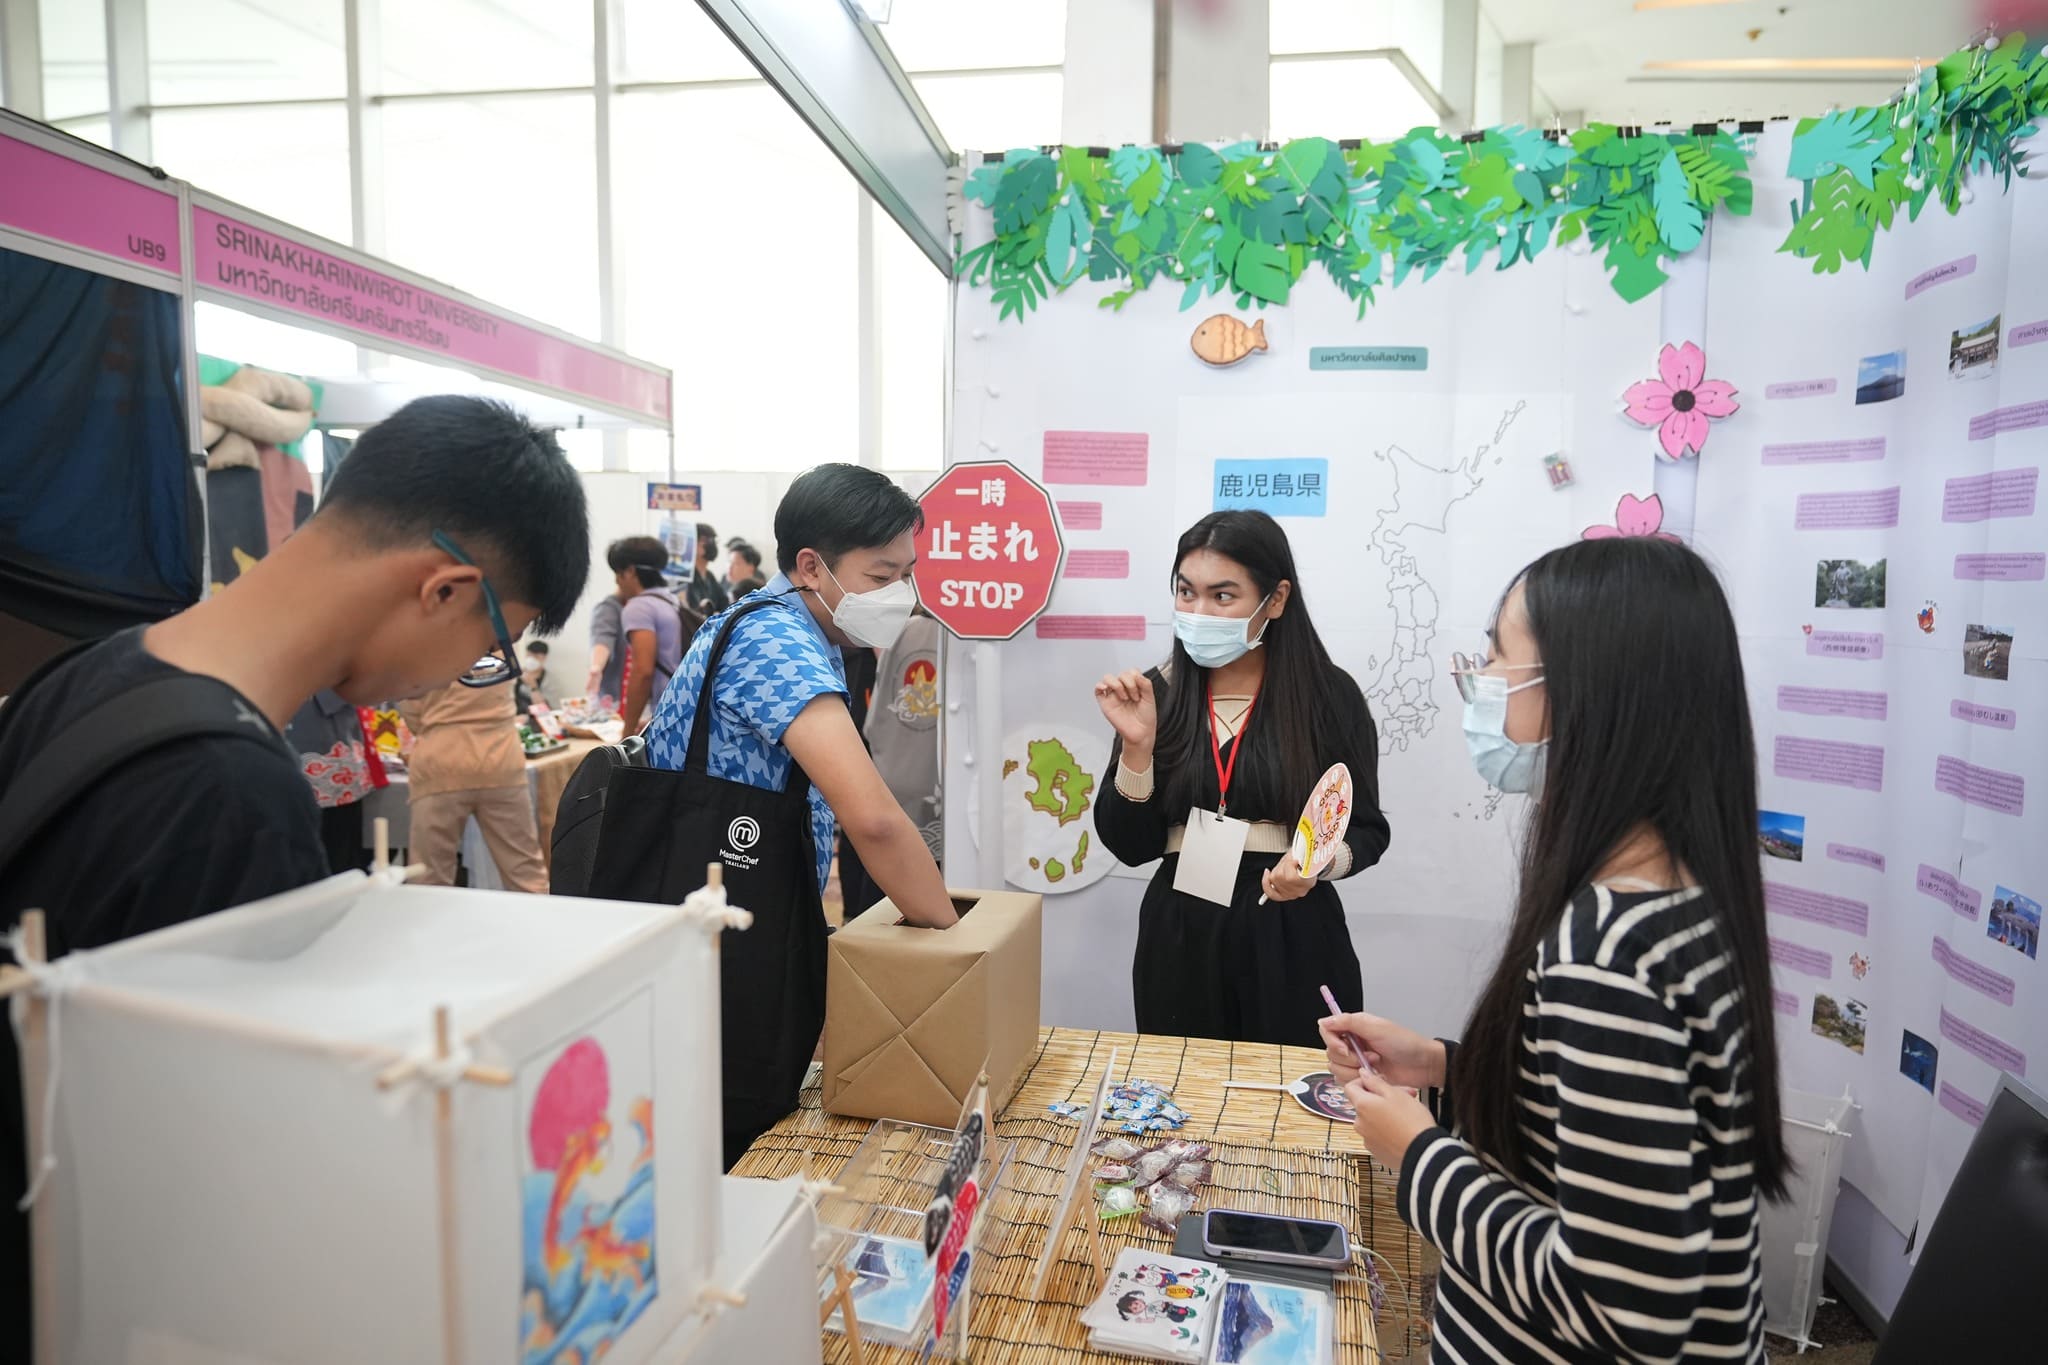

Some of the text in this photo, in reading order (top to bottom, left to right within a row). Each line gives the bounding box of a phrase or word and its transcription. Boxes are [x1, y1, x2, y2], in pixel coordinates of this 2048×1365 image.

[128, 234, 167, 262] UB9
[216, 223, 500, 338] SRINAKHARINWIROT UNIVERSITY
[1320, 351, 1417, 363] มหาวิทยาลัยศิลปากร
[955, 478, 1006, 507] 一時
[1219, 472, 1321, 498] 鹿児島県
[928, 520, 1039, 562] 止まれ
[940, 579, 1024, 609] STOP
[719, 848, 759, 865] MasterChef
[725, 860, 749, 870] THAILAND
